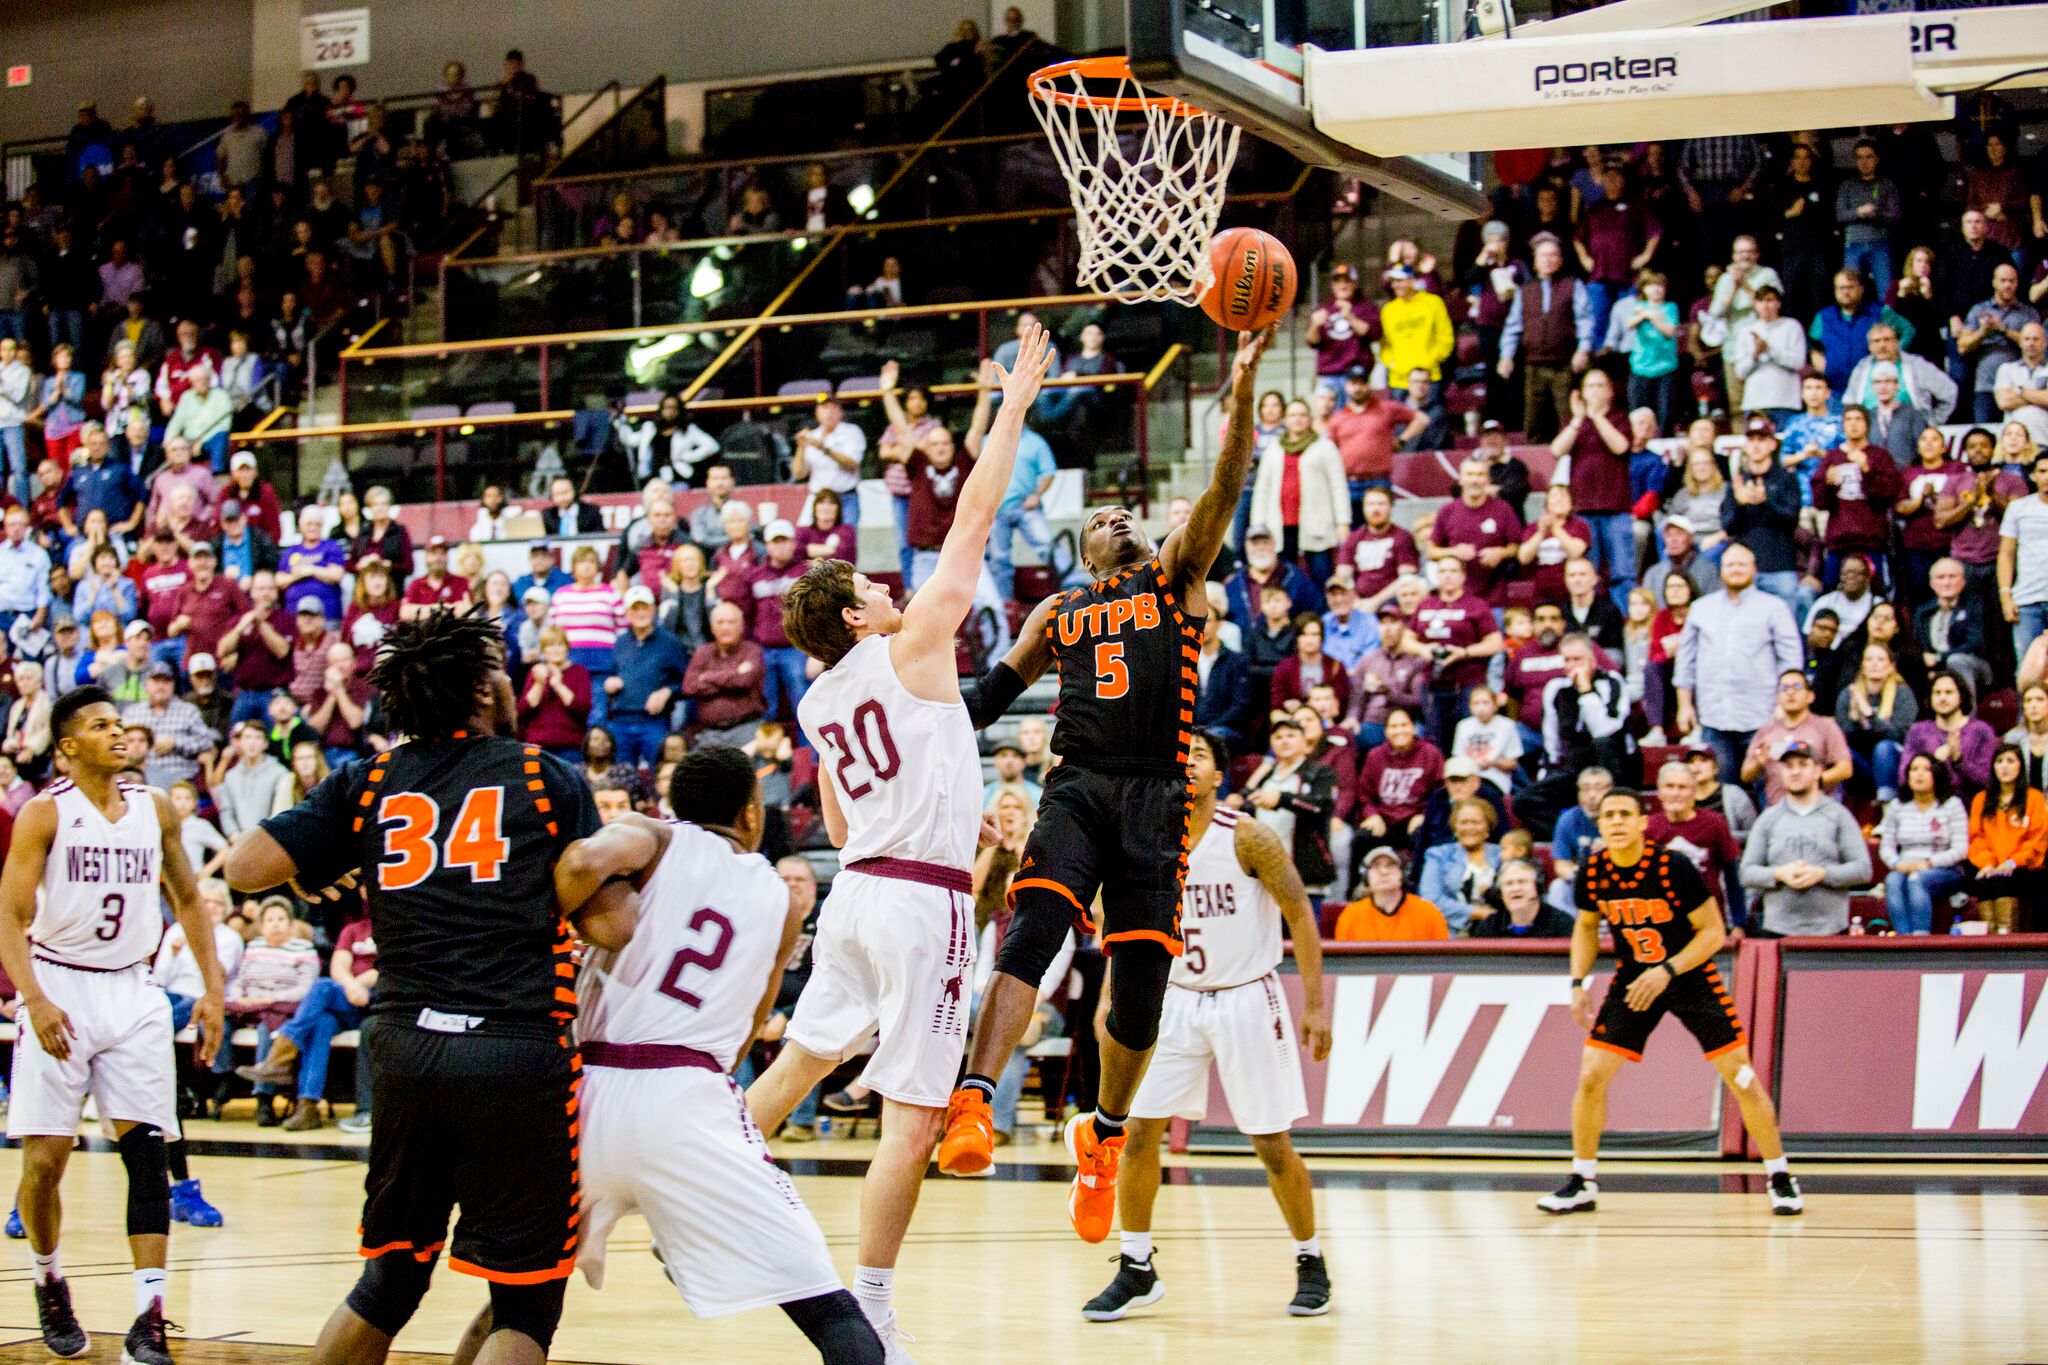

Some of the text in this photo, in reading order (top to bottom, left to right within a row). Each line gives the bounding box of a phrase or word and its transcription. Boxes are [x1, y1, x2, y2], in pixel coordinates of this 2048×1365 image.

[1230, 248, 1259, 316] Wilson
[1264, 262, 1285, 313] NCAA
[1058, 593, 1161, 647] UTPB
[1094, 641, 1130, 700] 5
[817, 696, 903, 803] 20
[66, 845, 110, 883] WEST
[376, 785, 511, 891] 34
[95, 893, 126, 942] 3
[1184, 883, 1236, 919] TEXAS
[1596, 897, 1674, 926] UTPB
[655, 904, 737, 1013] 2
[1183, 930, 1207, 975] 5
[1621, 927, 1668, 964] 13
[1322, 974, 1595, 1127] WT
